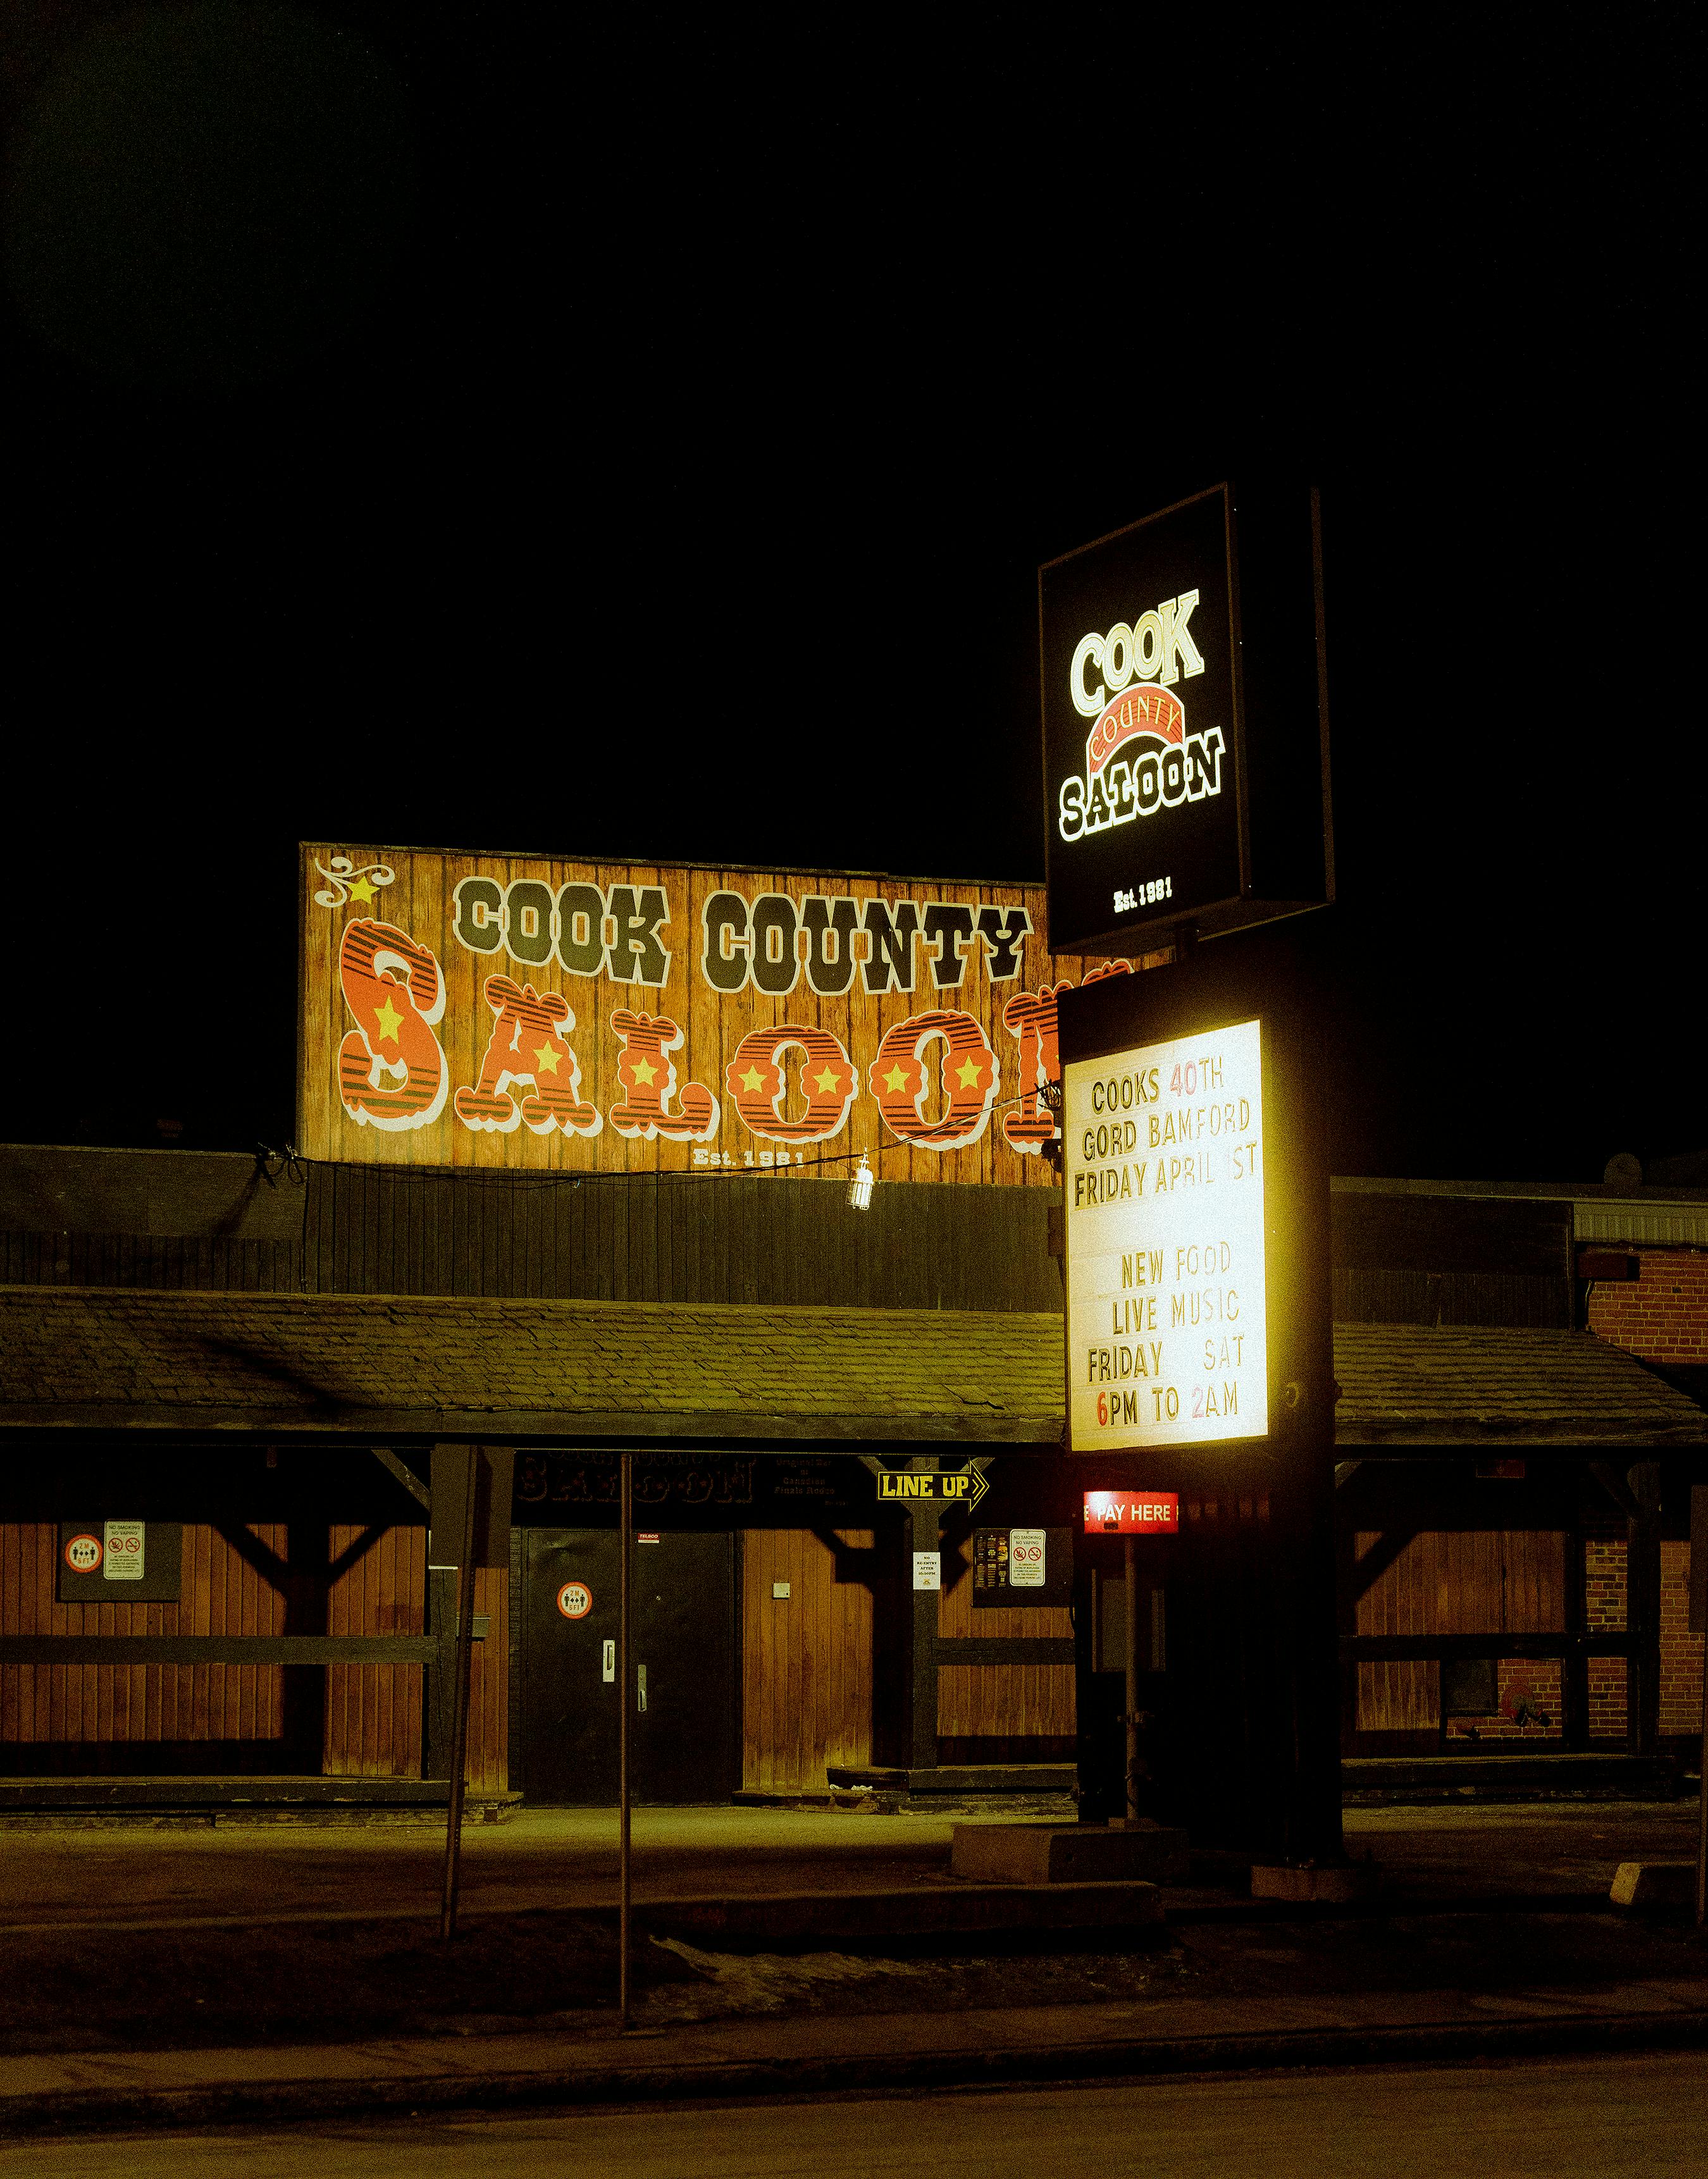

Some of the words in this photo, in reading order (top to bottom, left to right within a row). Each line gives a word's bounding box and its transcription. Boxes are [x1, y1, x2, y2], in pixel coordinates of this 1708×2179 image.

[1070, 589, 1204, 717] COOK
[1091, 695, 1180, 762] COUNTY
[1058, 726, 1225, 842] SALOON
[1139, 876, 1172, 906] 1981
[452, 876, 671, 987] COOK
[701, 890, 1034, 996] COUNTY
[1092, 1068, 1159, 1114] COOKS
[1170, 1054, 1223, 1097] 40TH
[1082, 1120, 1136, 1161] GORD
[1149, 1097, 1250, 1148] BAMFORD
[693, 1149, 736, 1166] Est.
[743, 1151, 803, 1168] 1981
[1075, 1163, 1147, 1207] FRIDAY
[1155, 1152, 1215, 1192] APRIL
[1122, 1249, 1163, 1288] NEW
[1176, 1241, 1230, 1280] FOOD
[1113, 1296, 1157, 1335] LIVE
[1172, 1288, 1239, 1328] MUSIC
[1088, 1341, 1162, 1382] FRIDAY
[1203, 1333, 1244, 1370] SAT
[1097, 1390, 1137, 1426] 6PM
[1152, 1386, 1179, 1421] TO
[1192, 1381, 1238, 1418] 2AM
[882, 1475, 933, 1497] LINE
[943, 1476, 969, 1497] UP
[1097, 1504, 1126, 1521] PAY
[1131, 1504, 1170, 1521] HERE
